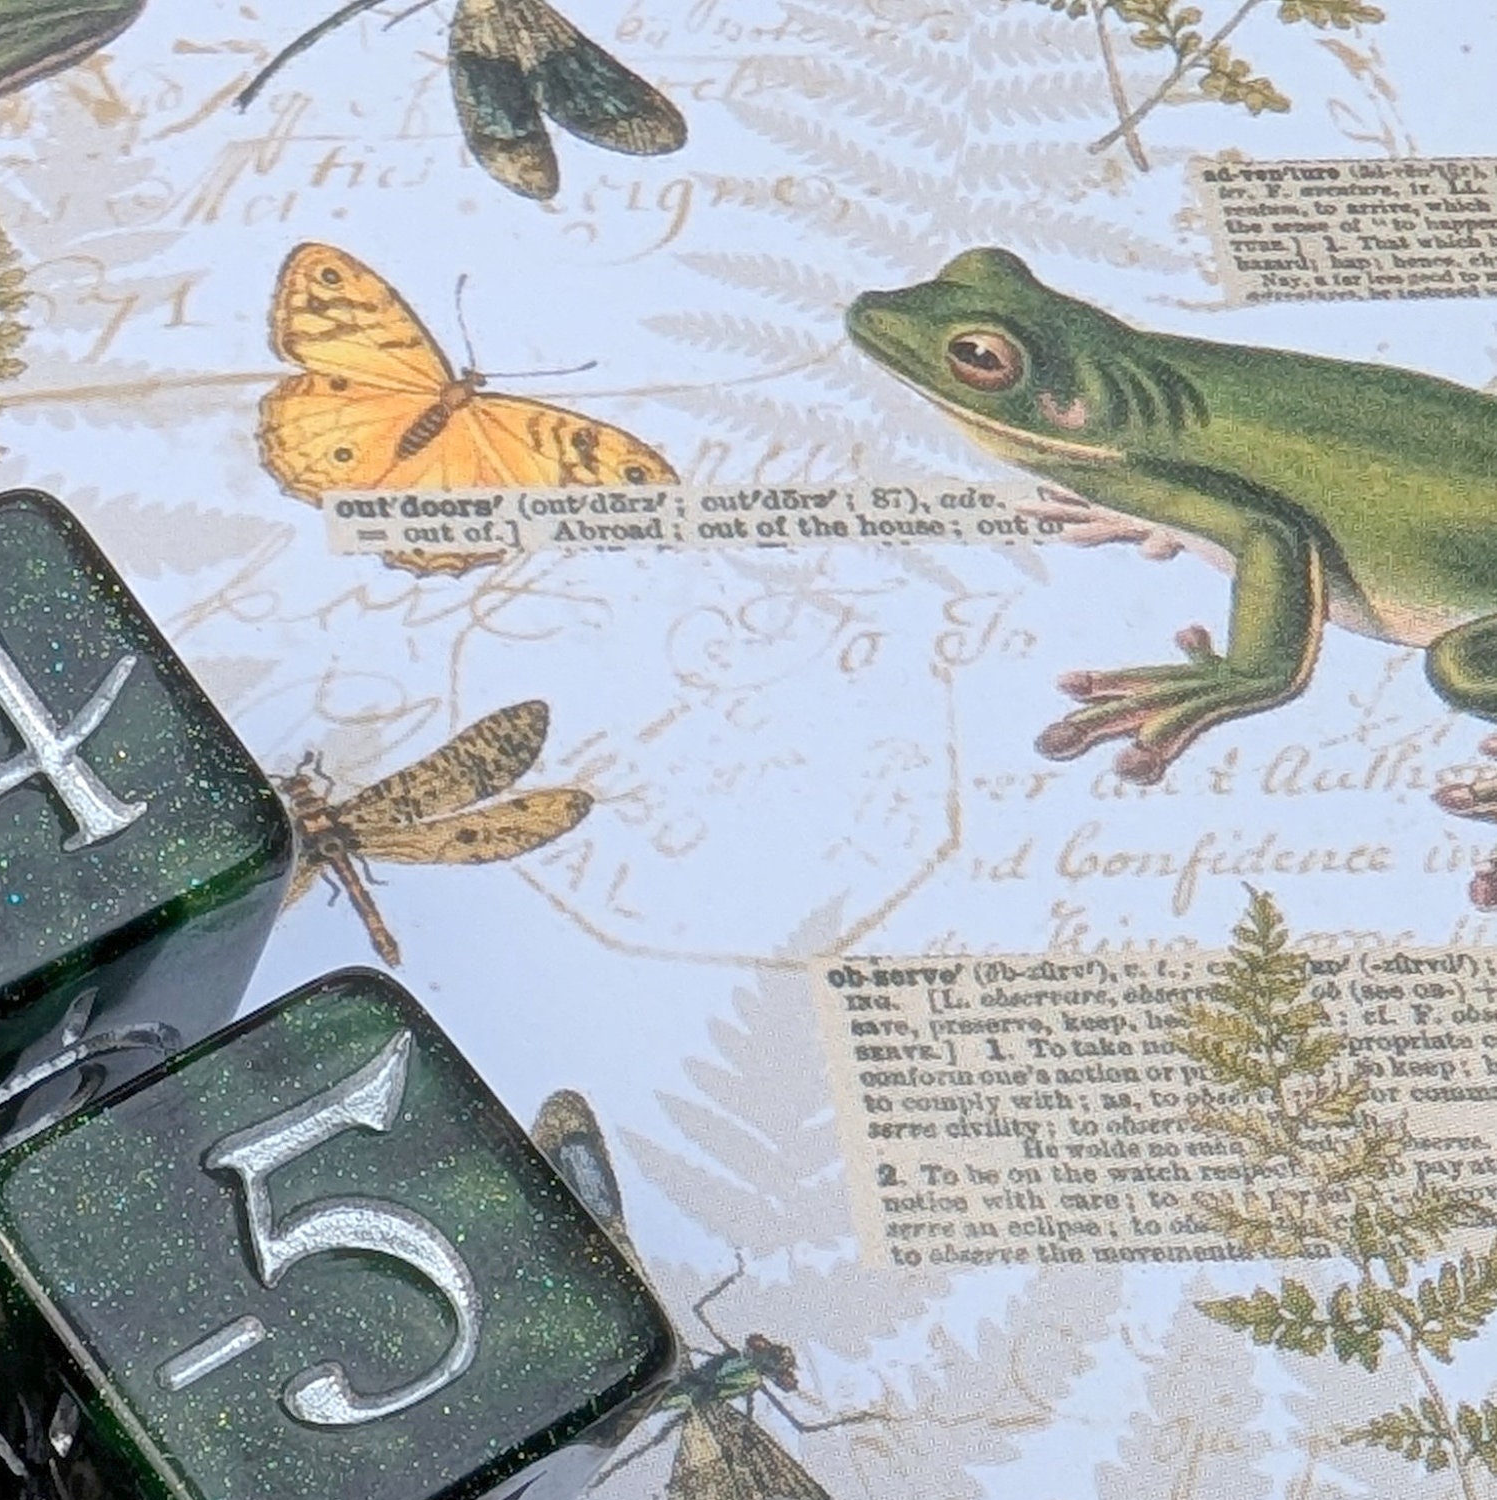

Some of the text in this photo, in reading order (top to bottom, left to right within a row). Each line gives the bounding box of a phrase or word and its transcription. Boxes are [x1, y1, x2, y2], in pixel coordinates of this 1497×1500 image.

[1314, 198, 1492, 217] to arrive, which
[1225, 219, 1263, 234] the
[1339, 218, 1361, 233] of
[1357, 233, 1483, 250] That which
[939, 486, 1007, 510] adv.
[402, 524, 455, 544] out
[697, 518, 748, 539] out
[755, 515, 788, 538] of
[797, 515, 849, 538] the
[976, 515, 1030, 537] out
[928, 1016, 1054, 1041] preserve,
[1060, 1012, 1139, 1035] keep,
[1028, 1036, 1134, 1060] To take
[858, 1064, 1173, 1088] conform one's action or
[863, 1092, 1000, 1118] to comply
[1068, 1116, 1099, 1136] to
[919, 1160, 1192, 1185] To be on the watch
[982, 1188, 1047, 1211] with
[1148, 1189, 1179, 1209] to
[163, 1033, 485, 1431] -5
[963, 1215, 1162, 1239] an to
[890, 1245, 922, 1267] to
[1037, 1242, 1085, 1264] the
